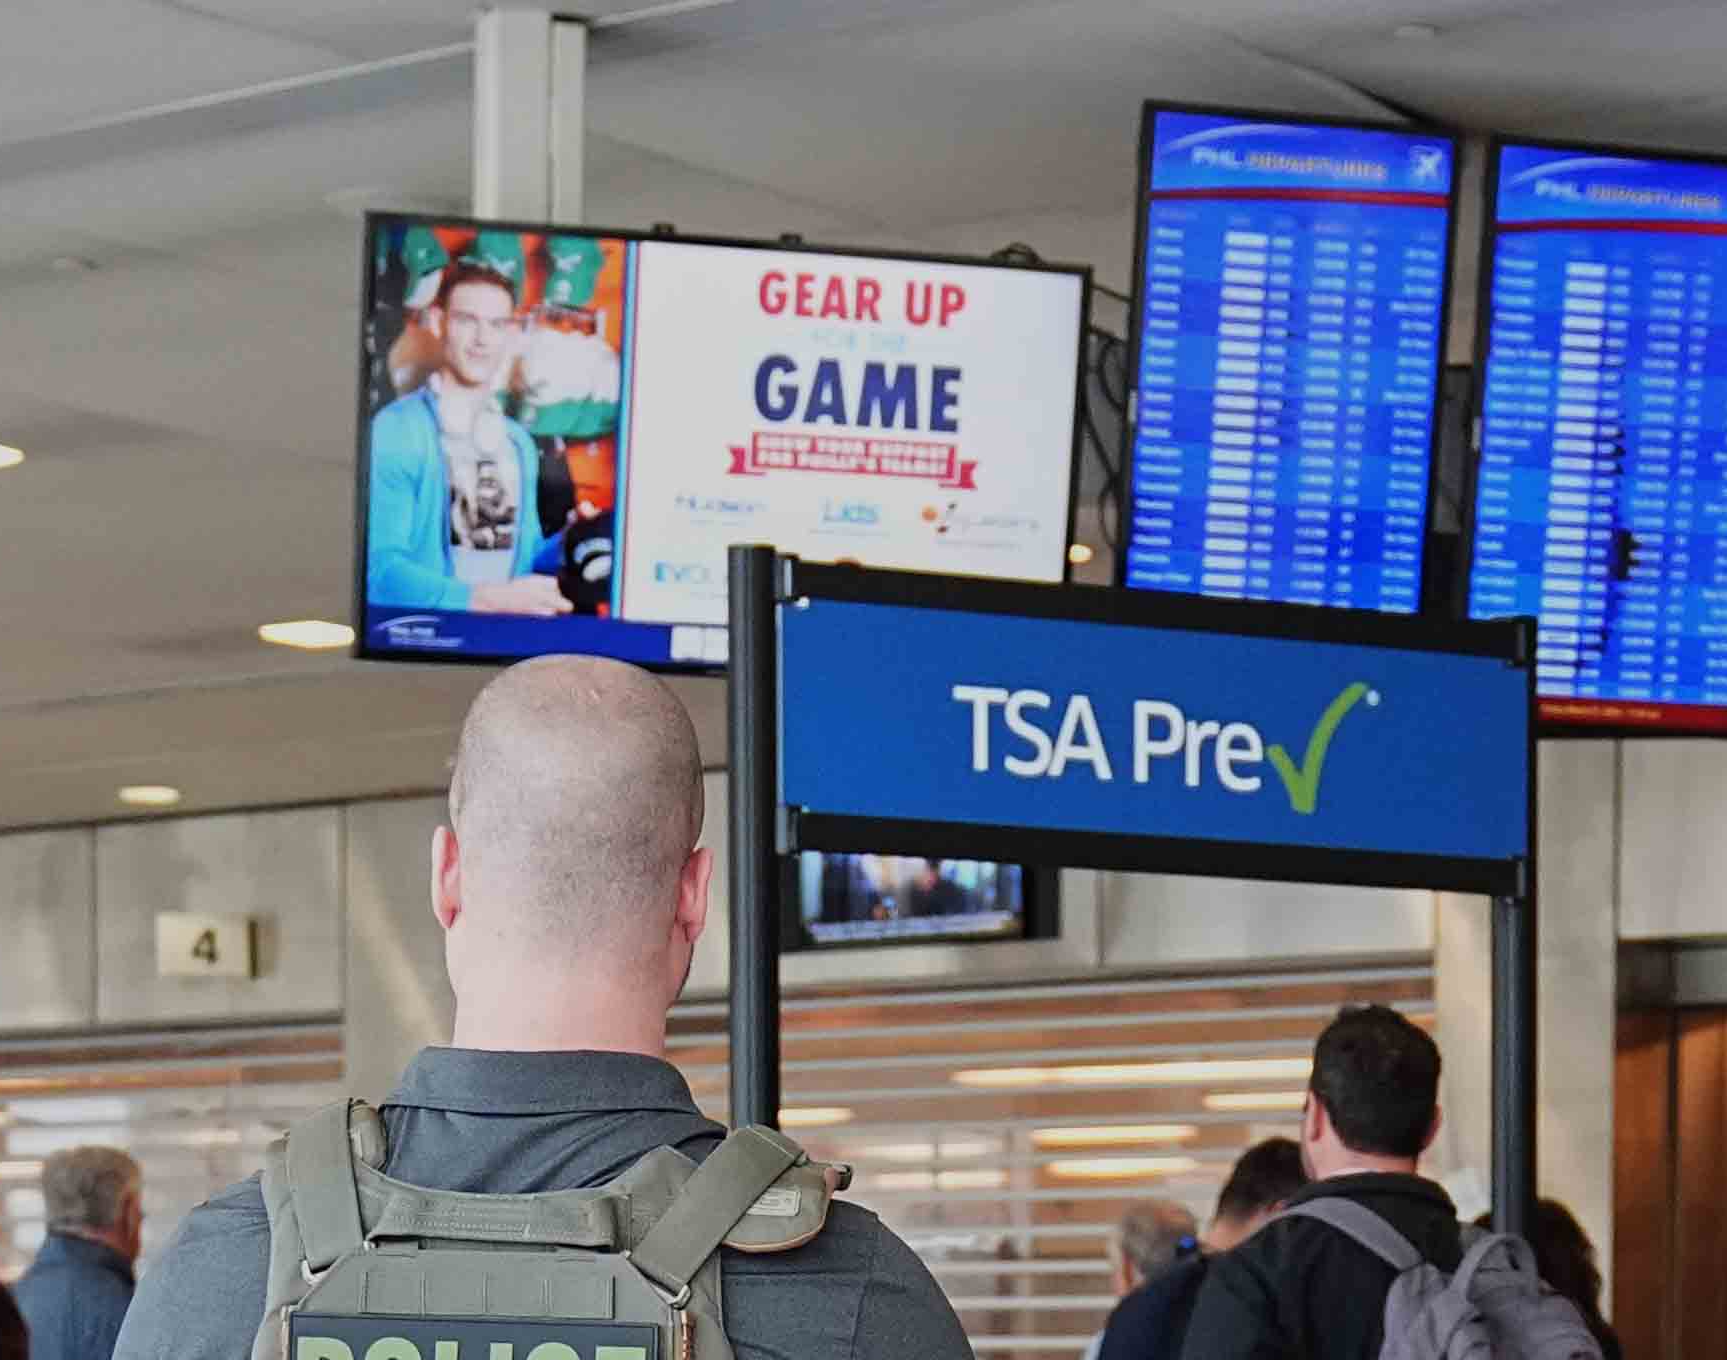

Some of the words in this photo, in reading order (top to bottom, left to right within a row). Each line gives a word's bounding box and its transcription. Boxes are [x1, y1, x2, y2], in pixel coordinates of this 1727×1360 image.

[759, 270, 882, 323] GEAR
[904, 281, 968, 328] UP
[754, 353, 964, 434] GAME
[952, 685, 1113, 781] TSA
[1132, 699, 1263, 793] Pre
[192, 928, 217, 964] 4
